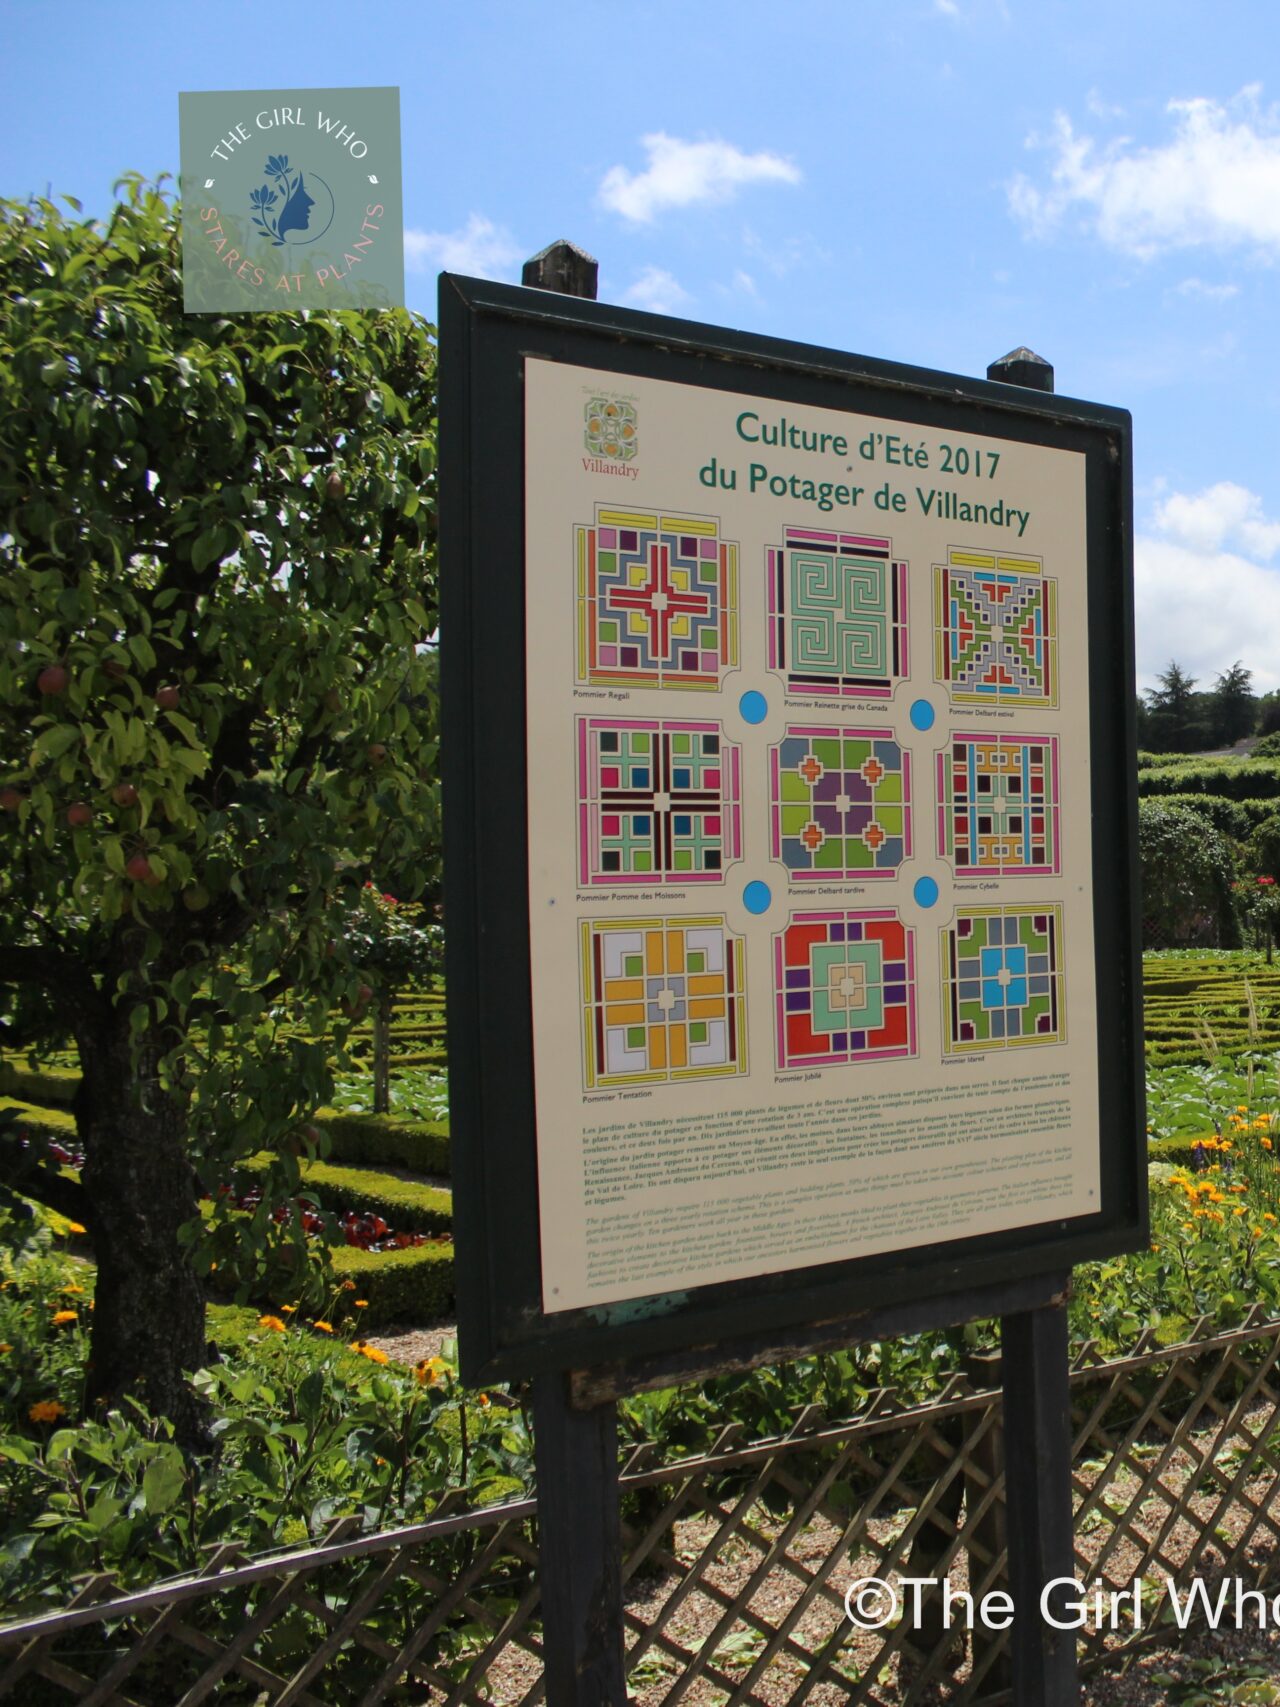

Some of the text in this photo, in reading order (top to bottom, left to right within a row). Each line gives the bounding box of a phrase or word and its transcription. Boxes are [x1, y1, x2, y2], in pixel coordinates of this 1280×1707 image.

[736, 412, 1001, 480] Culture d'Eté 2017
[582, 458, 640, 481] Villandry
[699, 458, 1030, 537] du Potager de Villandry
[573, 689, 607, 698] Pommier
[784, 700, 813, 708] Pommier
[814, 701, 840, 709] Reinette
[841, 703, 855, 711] grise
[576, 893, 610, 901] Pommier
[640, 892, 653, 900] des
[940, 1055, 985, 1066] Pommier Idared
[774, 1072, 822, 1083] Pommier Jubilé
[582, 1090, 653, 1104] Pommier Tentation
